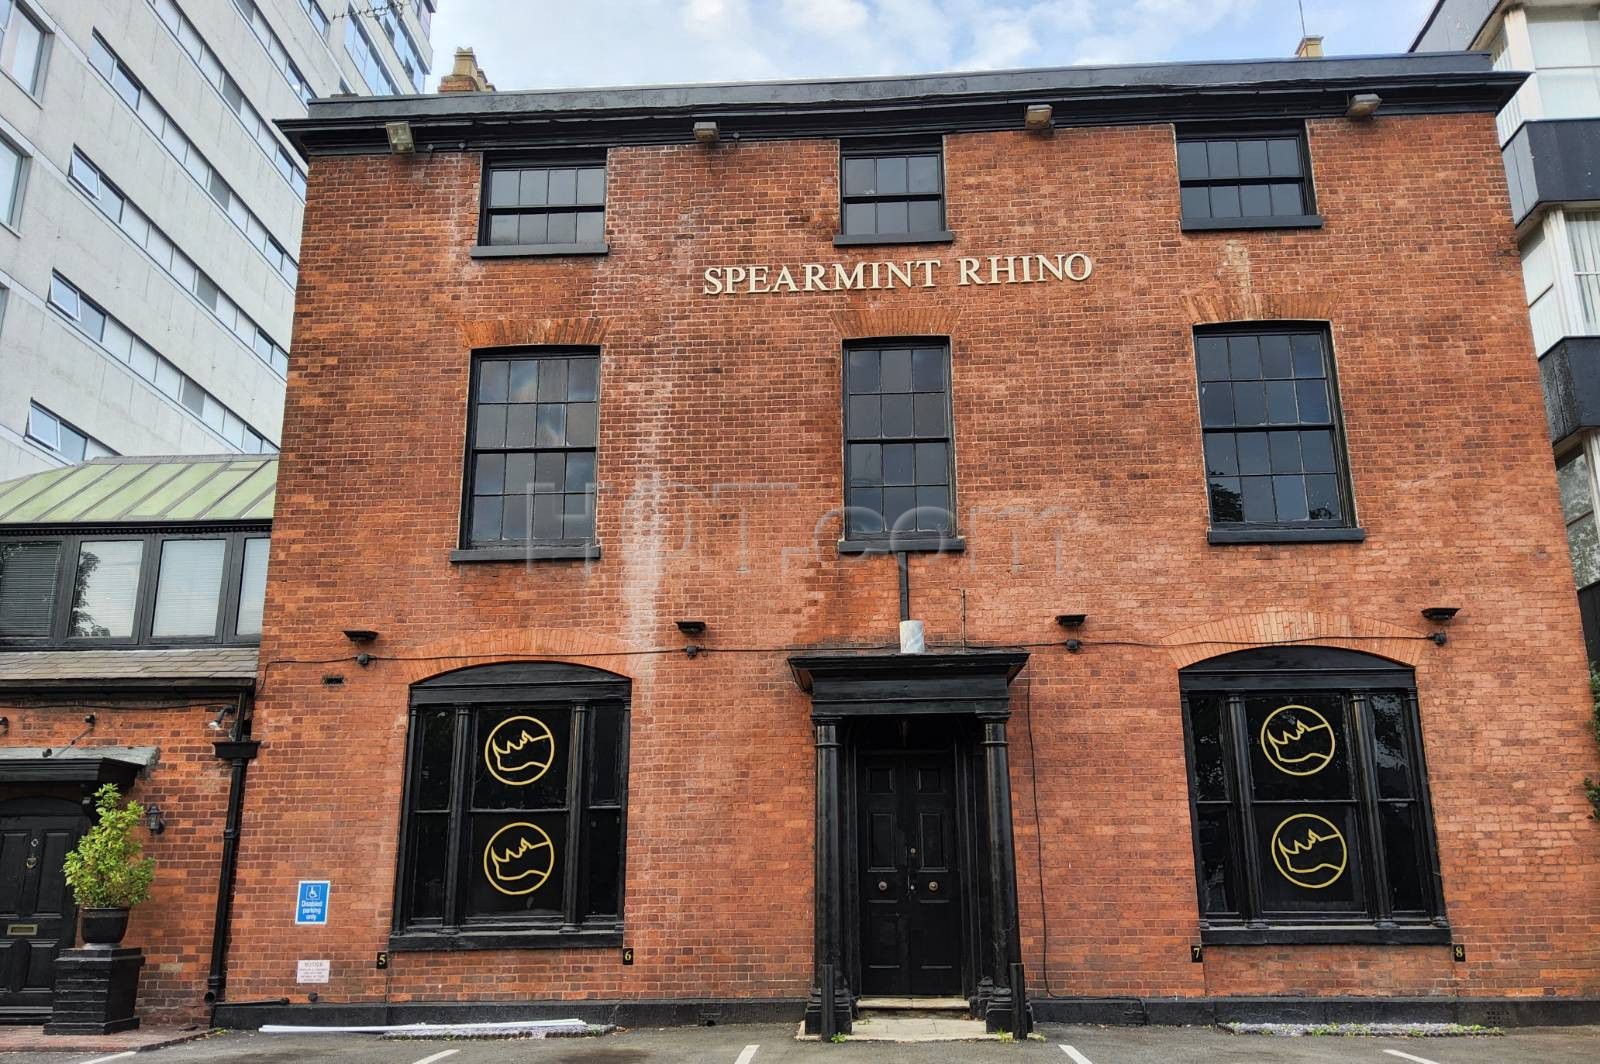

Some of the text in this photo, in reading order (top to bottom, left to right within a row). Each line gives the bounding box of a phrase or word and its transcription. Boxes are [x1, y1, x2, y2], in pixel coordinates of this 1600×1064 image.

[703, 252, 1093, 296] SPEARMINT RHINO
[624, 950, 632, 961] 6
[1193, 947, 1200, 958] 7
[1455, 946, 1463, 958] 8
[379, 954, 386, 965] 5
